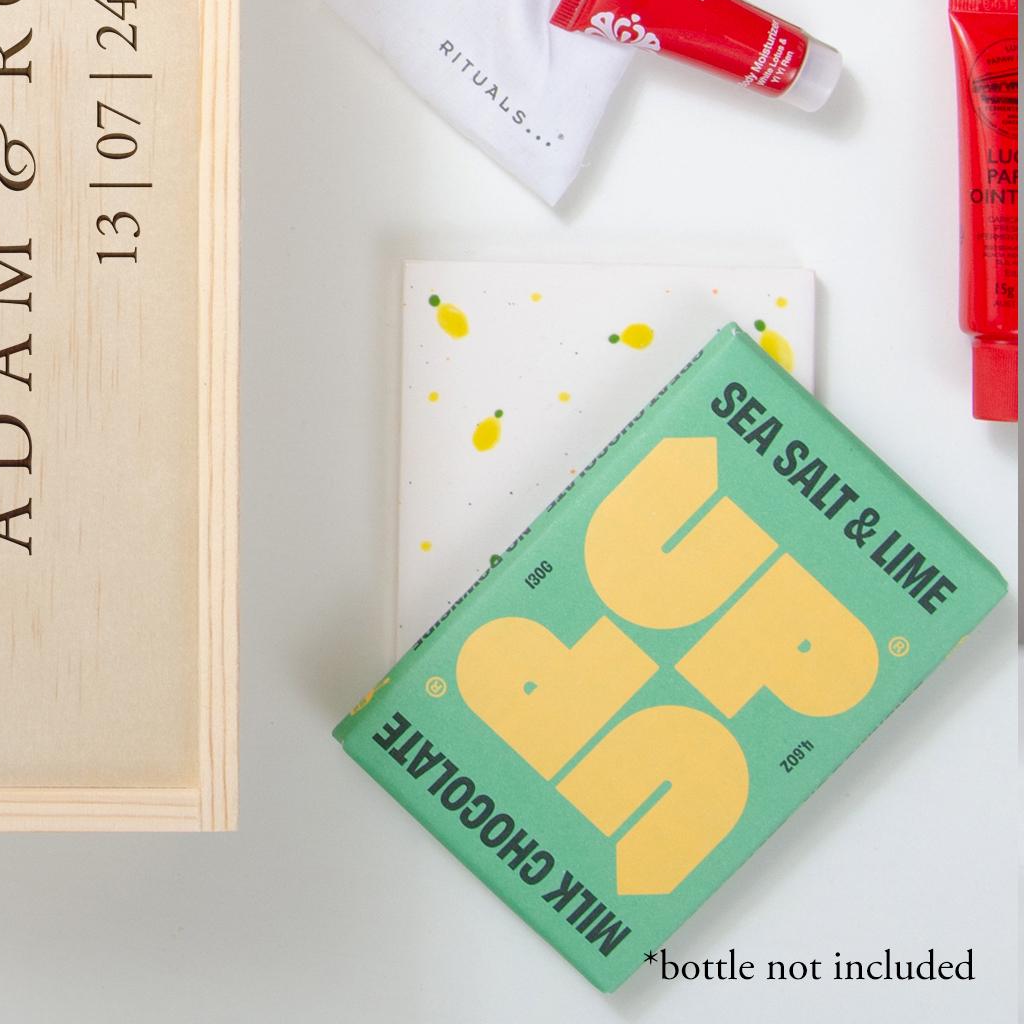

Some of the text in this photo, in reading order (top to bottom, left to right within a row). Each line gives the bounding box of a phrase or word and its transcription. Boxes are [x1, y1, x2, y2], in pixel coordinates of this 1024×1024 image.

[758, 67, 774, 86] White
[769, 46, 785, 68] Lotus
[781, 51, 794, 67] Ren
[970, 188, 1018, 204] OINT
[712, 383, 782, 456] SEA
[774, 441, 860, 520] SALT
[843, 507, 880, 549] &
[870, 530, 958, 615] LIME
[524, 559, 554, 589] 130G
[372, 711, 632, 957] MILK CHOCOLATE
